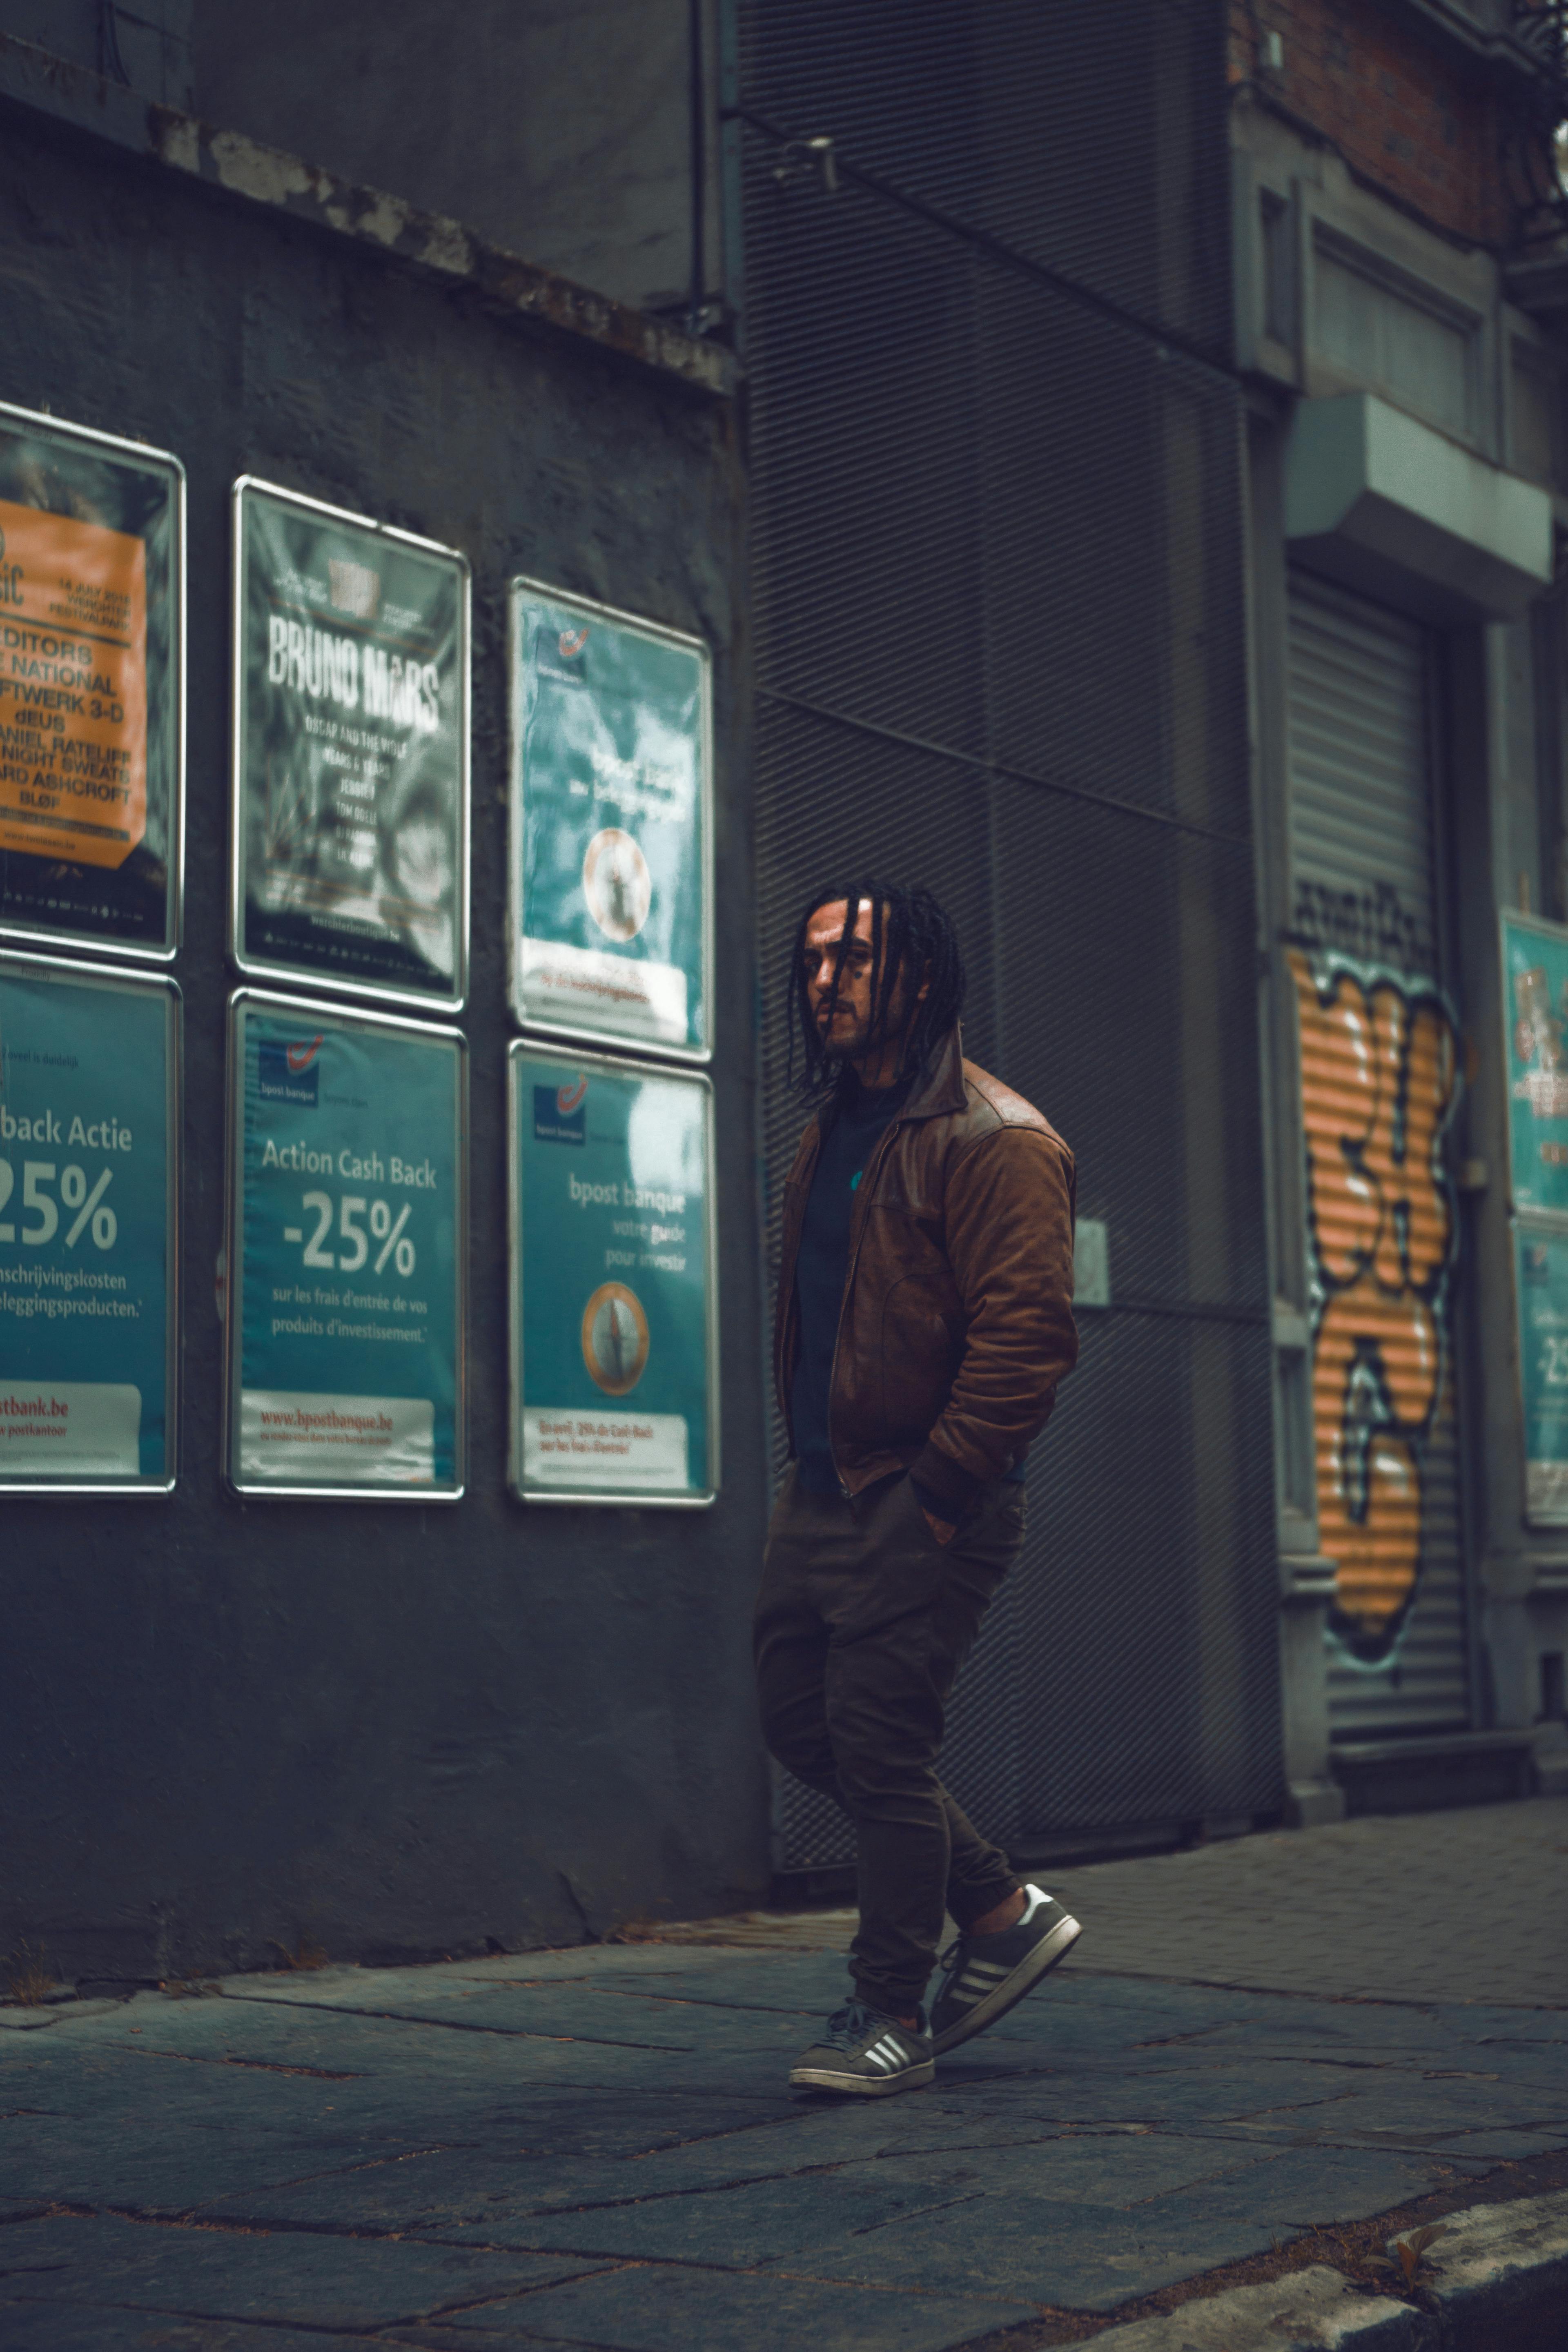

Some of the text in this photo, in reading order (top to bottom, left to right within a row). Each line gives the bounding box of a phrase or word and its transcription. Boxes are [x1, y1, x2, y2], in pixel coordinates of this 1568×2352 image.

[0, 625, 92, 666] DITORS
[12, 654, 117, 698] NATIONAL
[268, 613, 440, 732] BRUNO MARS
[15, 708, 65, 733] dEUS
[90, 698, 125, 724] 3-D
[2, 743, 131, 785] NIGHT SWEATS
[33, 771, 131, 806] ASHCROFT
[261, 1082, 315, 1101] bpost banque
[1, 1105, 133, 1152] back Actie
[261, 1138, 437, 1189] Action Cash Back
[570, 1172, 619, 1209] bpost
[284, 1189, 416, 1277] -25%
[272, 1287, 291, 1303] sur
[294, 1285, 312, 1304] les
[313, 1287, 340, 1306] frais
[392, 1294, 407, 1312] de
[409, 1300, 428, 1315] vos
[271, 1314, 324, 1337] produits
[8, 1422, 67, 1441] postkantoor
[261, 1408, 393, 1434] www.bpostbanque.be
